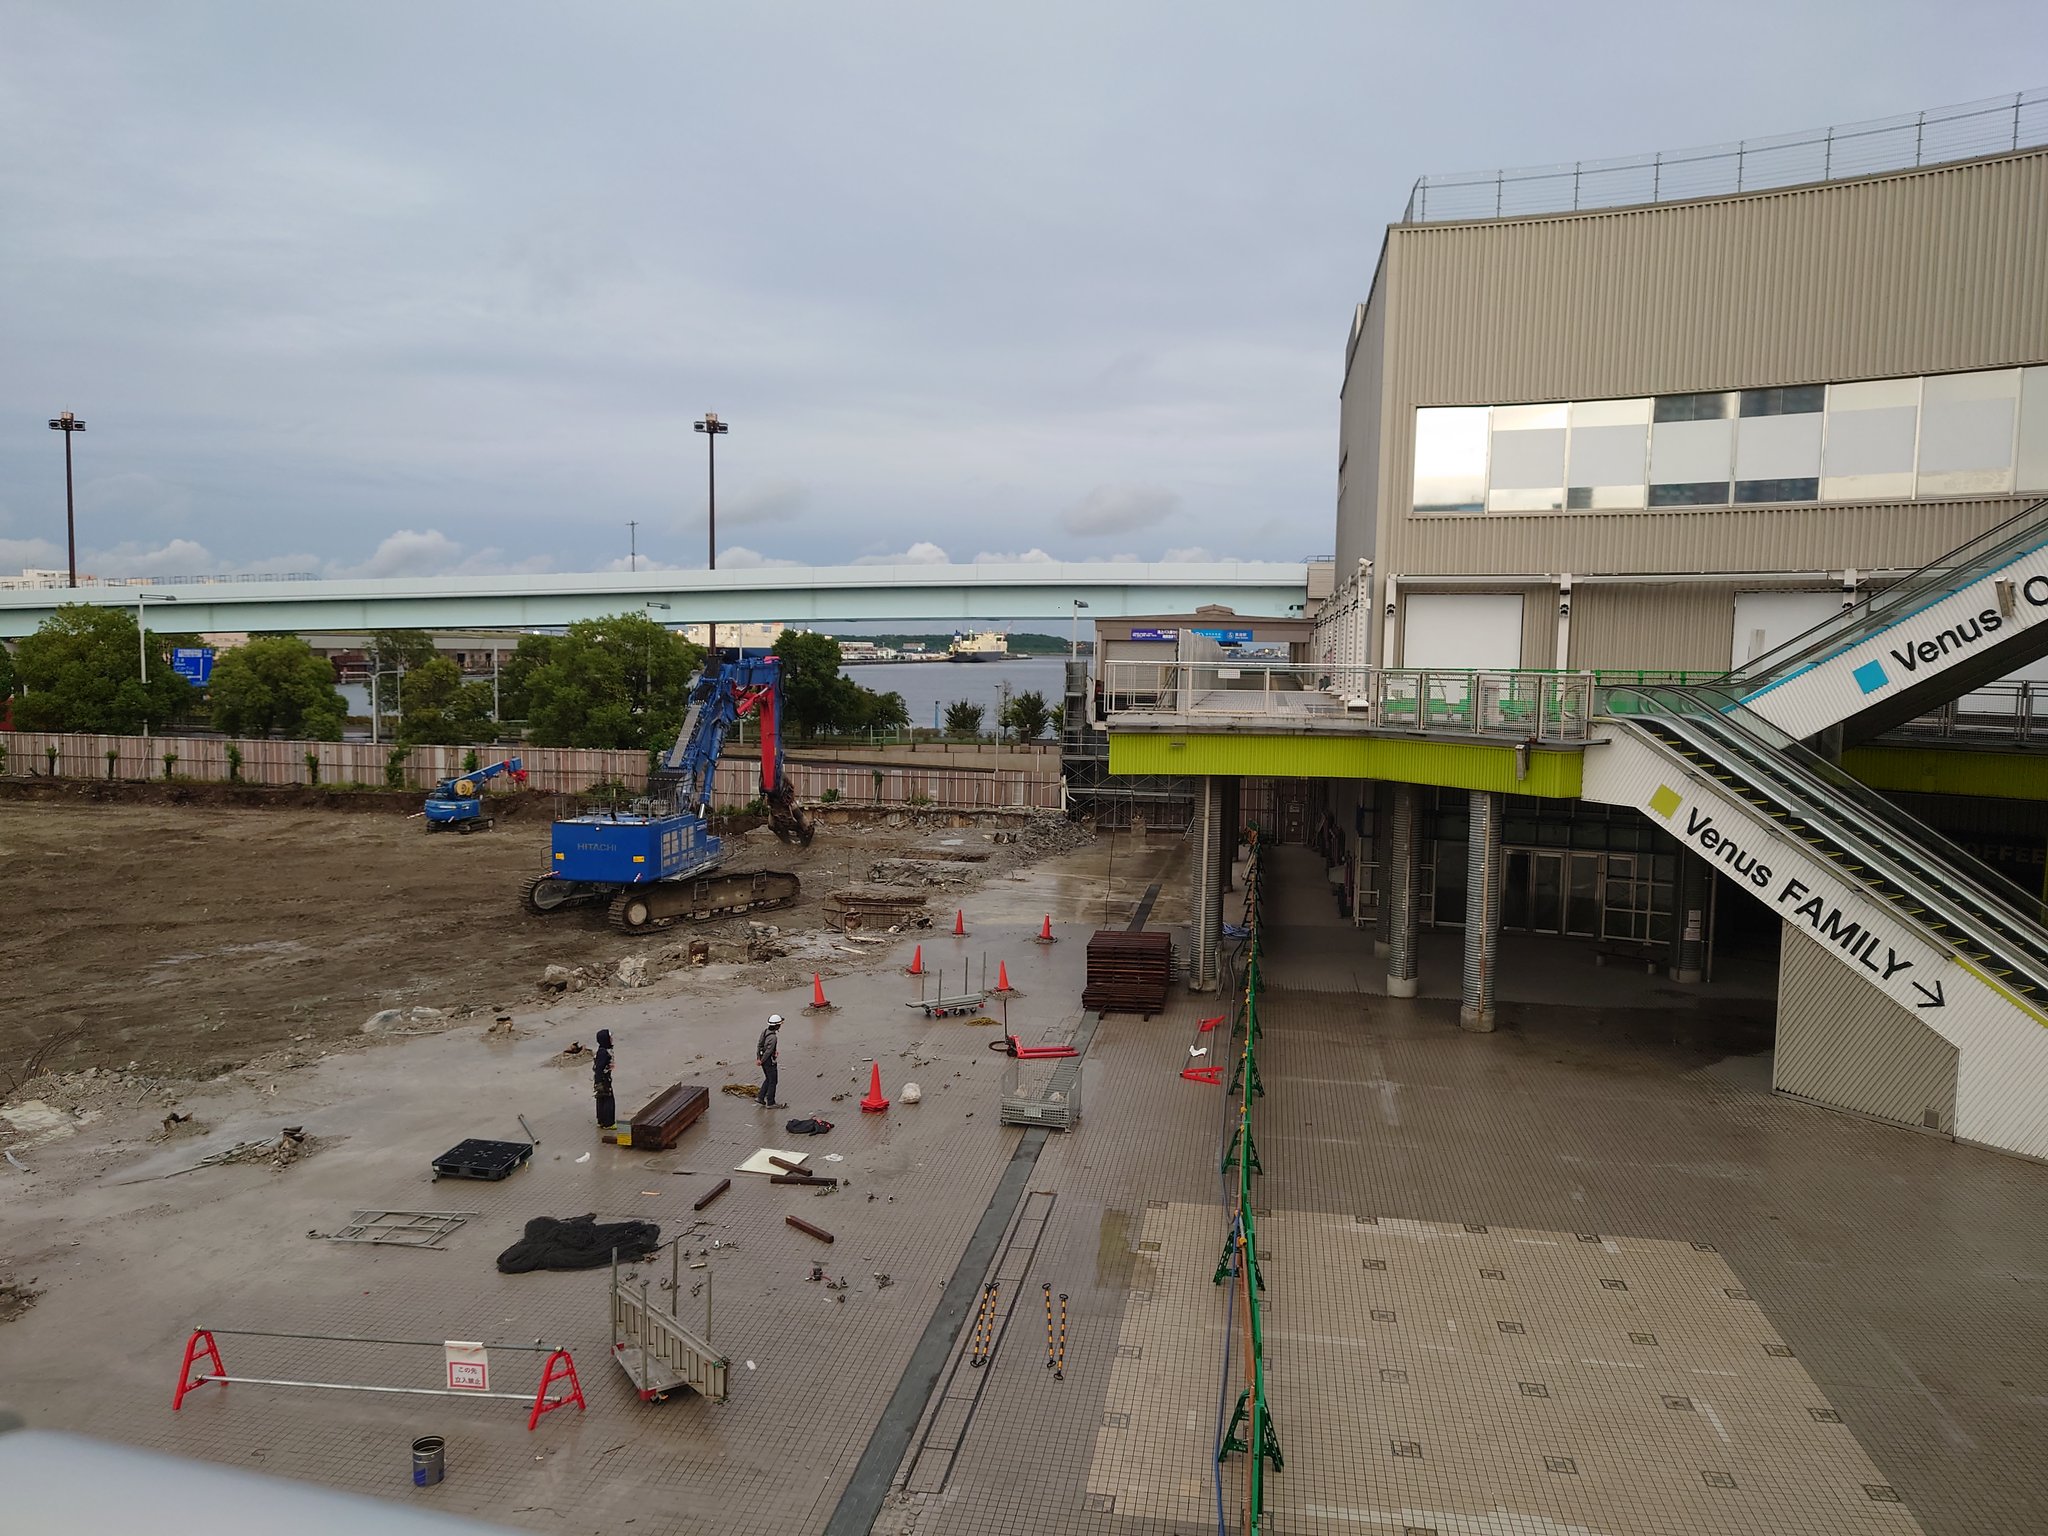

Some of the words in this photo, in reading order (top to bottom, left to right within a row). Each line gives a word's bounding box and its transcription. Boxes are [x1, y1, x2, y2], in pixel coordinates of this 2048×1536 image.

[1889, 608, 2003, 672] Venus
[577, 842, 617, 852] HITACHI
[1685, 806, 1774, 888] Venus
[1777, 877, 1914, 981] FAMILY
[454, 1376, 481, 1385] 立入禁止
